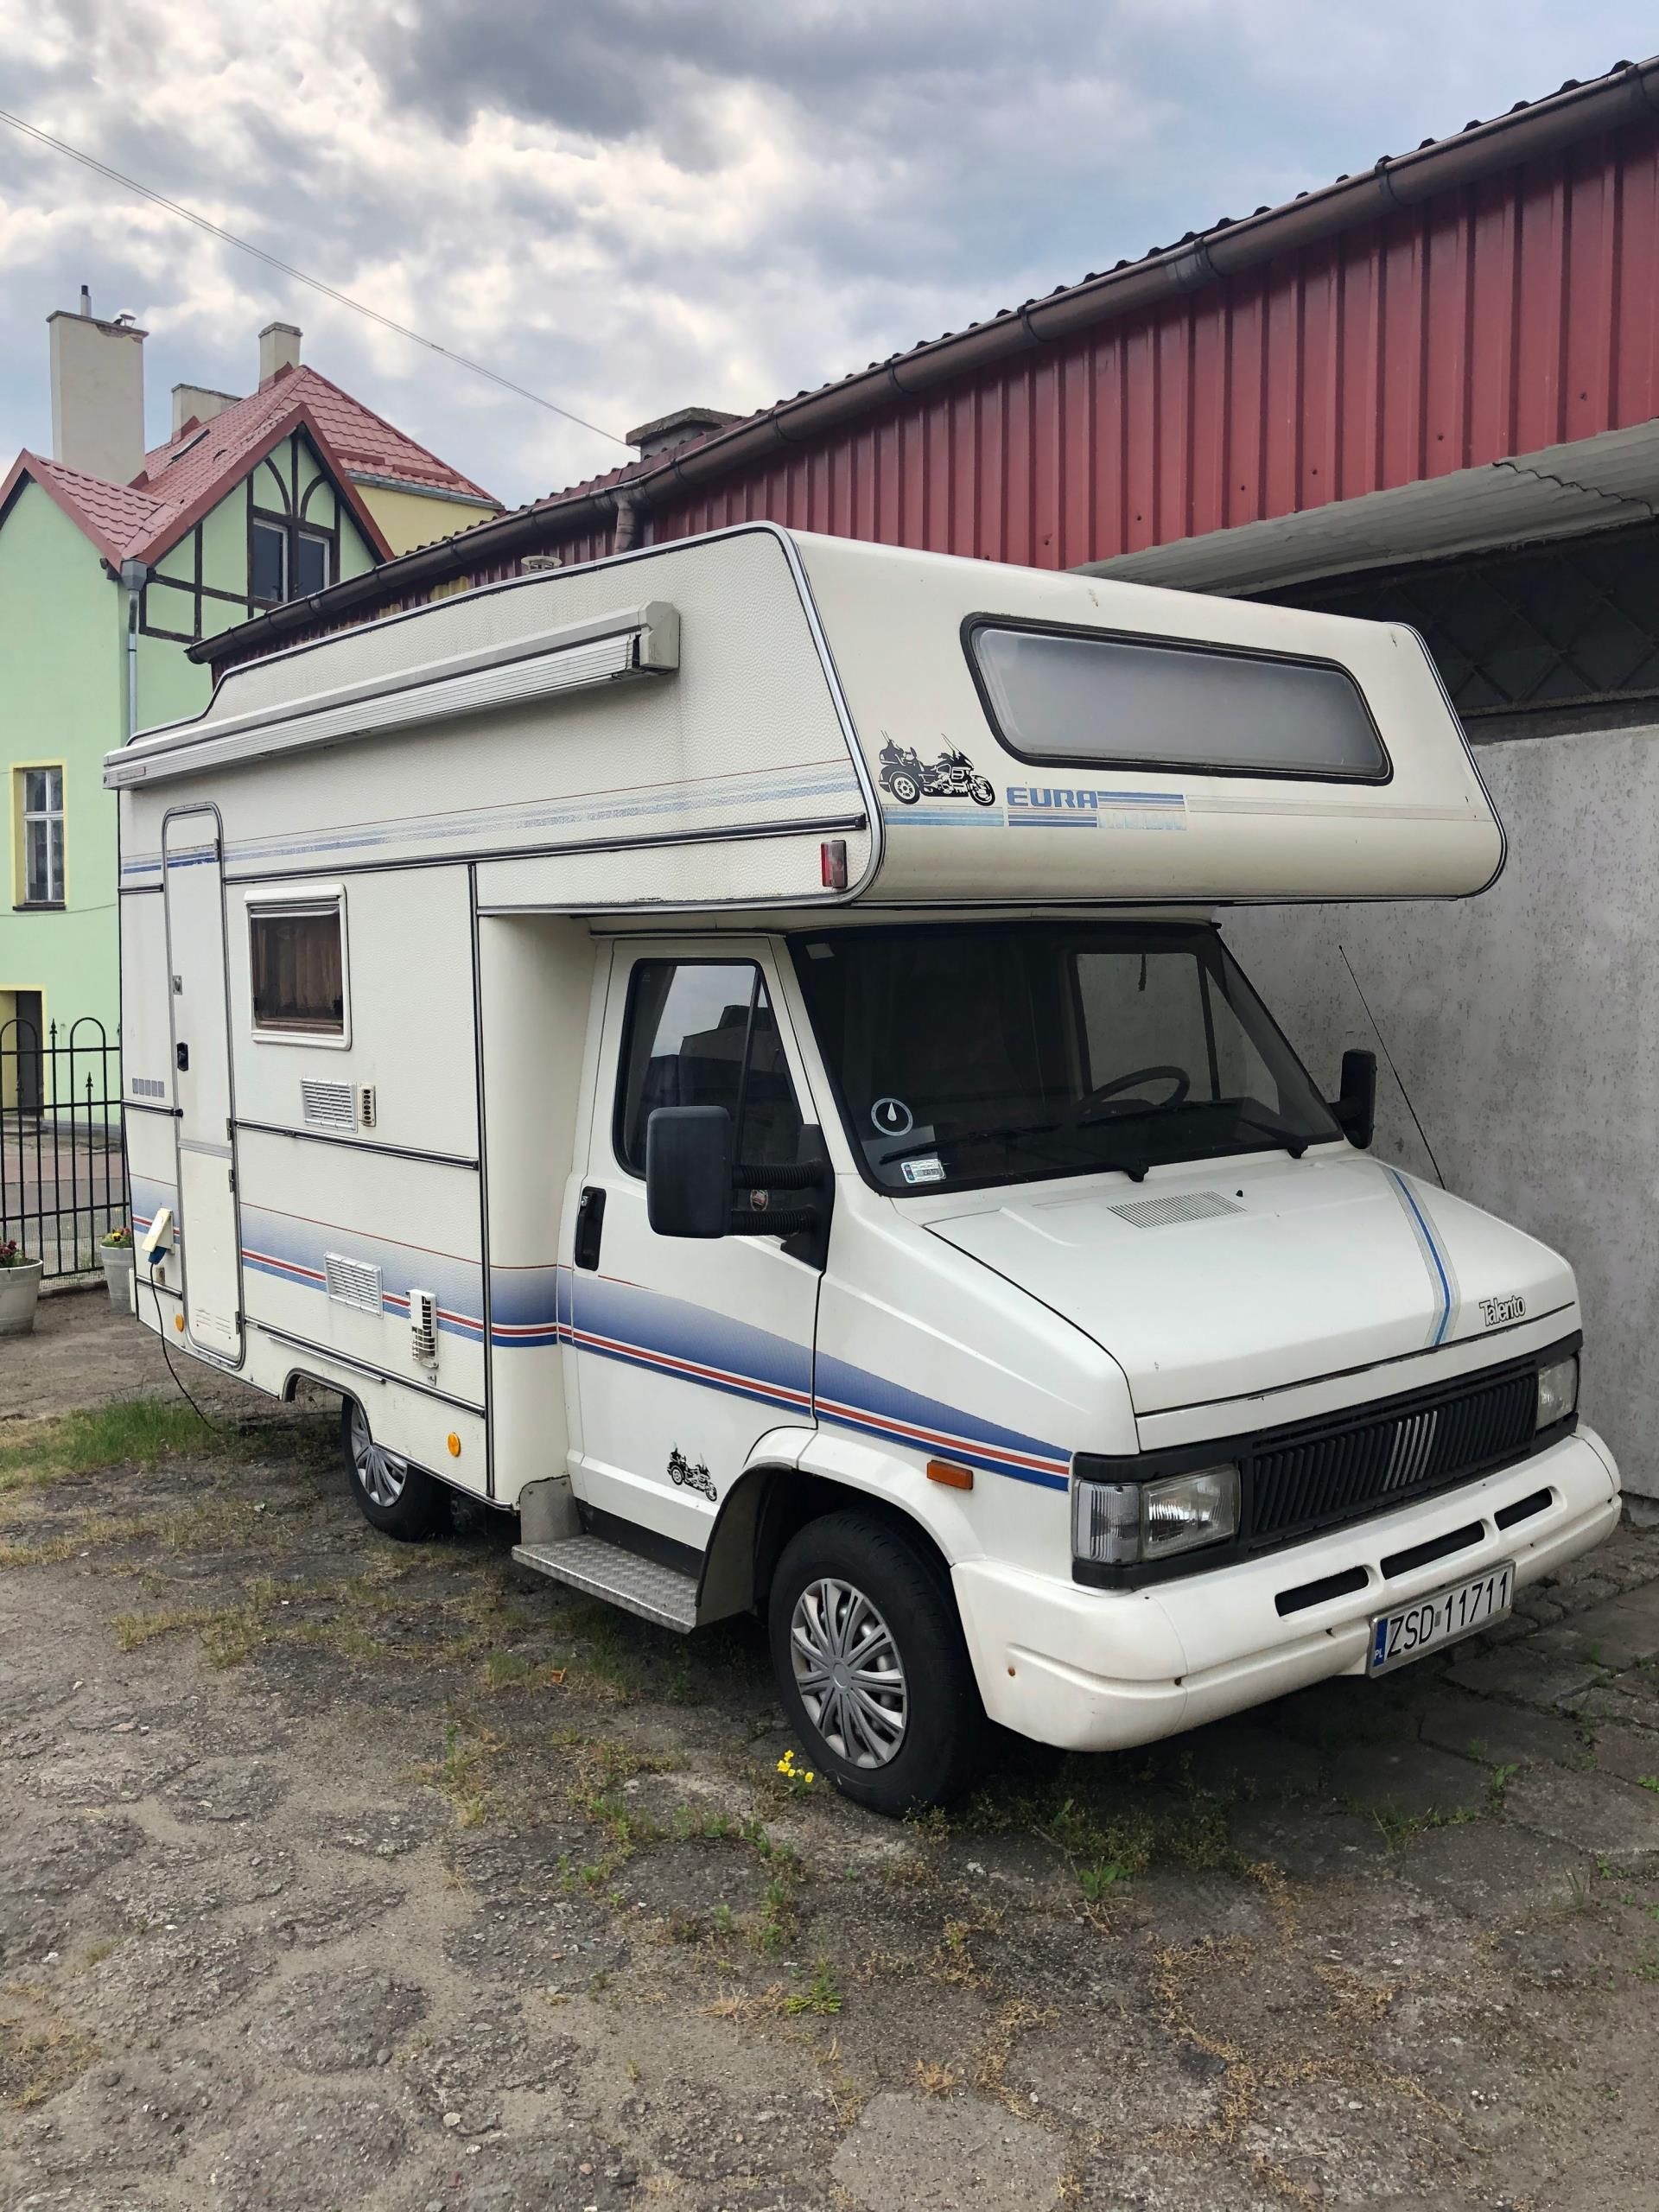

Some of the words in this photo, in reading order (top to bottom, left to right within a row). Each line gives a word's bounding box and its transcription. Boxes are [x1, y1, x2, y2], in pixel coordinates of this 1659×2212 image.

[1007, 787, 1098, 809] EURA
[1479, 1295, 1526, 1326] Talento
[1387, 1605, 1434, 1658] ZSD
[1445, 1571, 1508, 1633] 11711
[1374, 1649, 1383, 1659] PL
